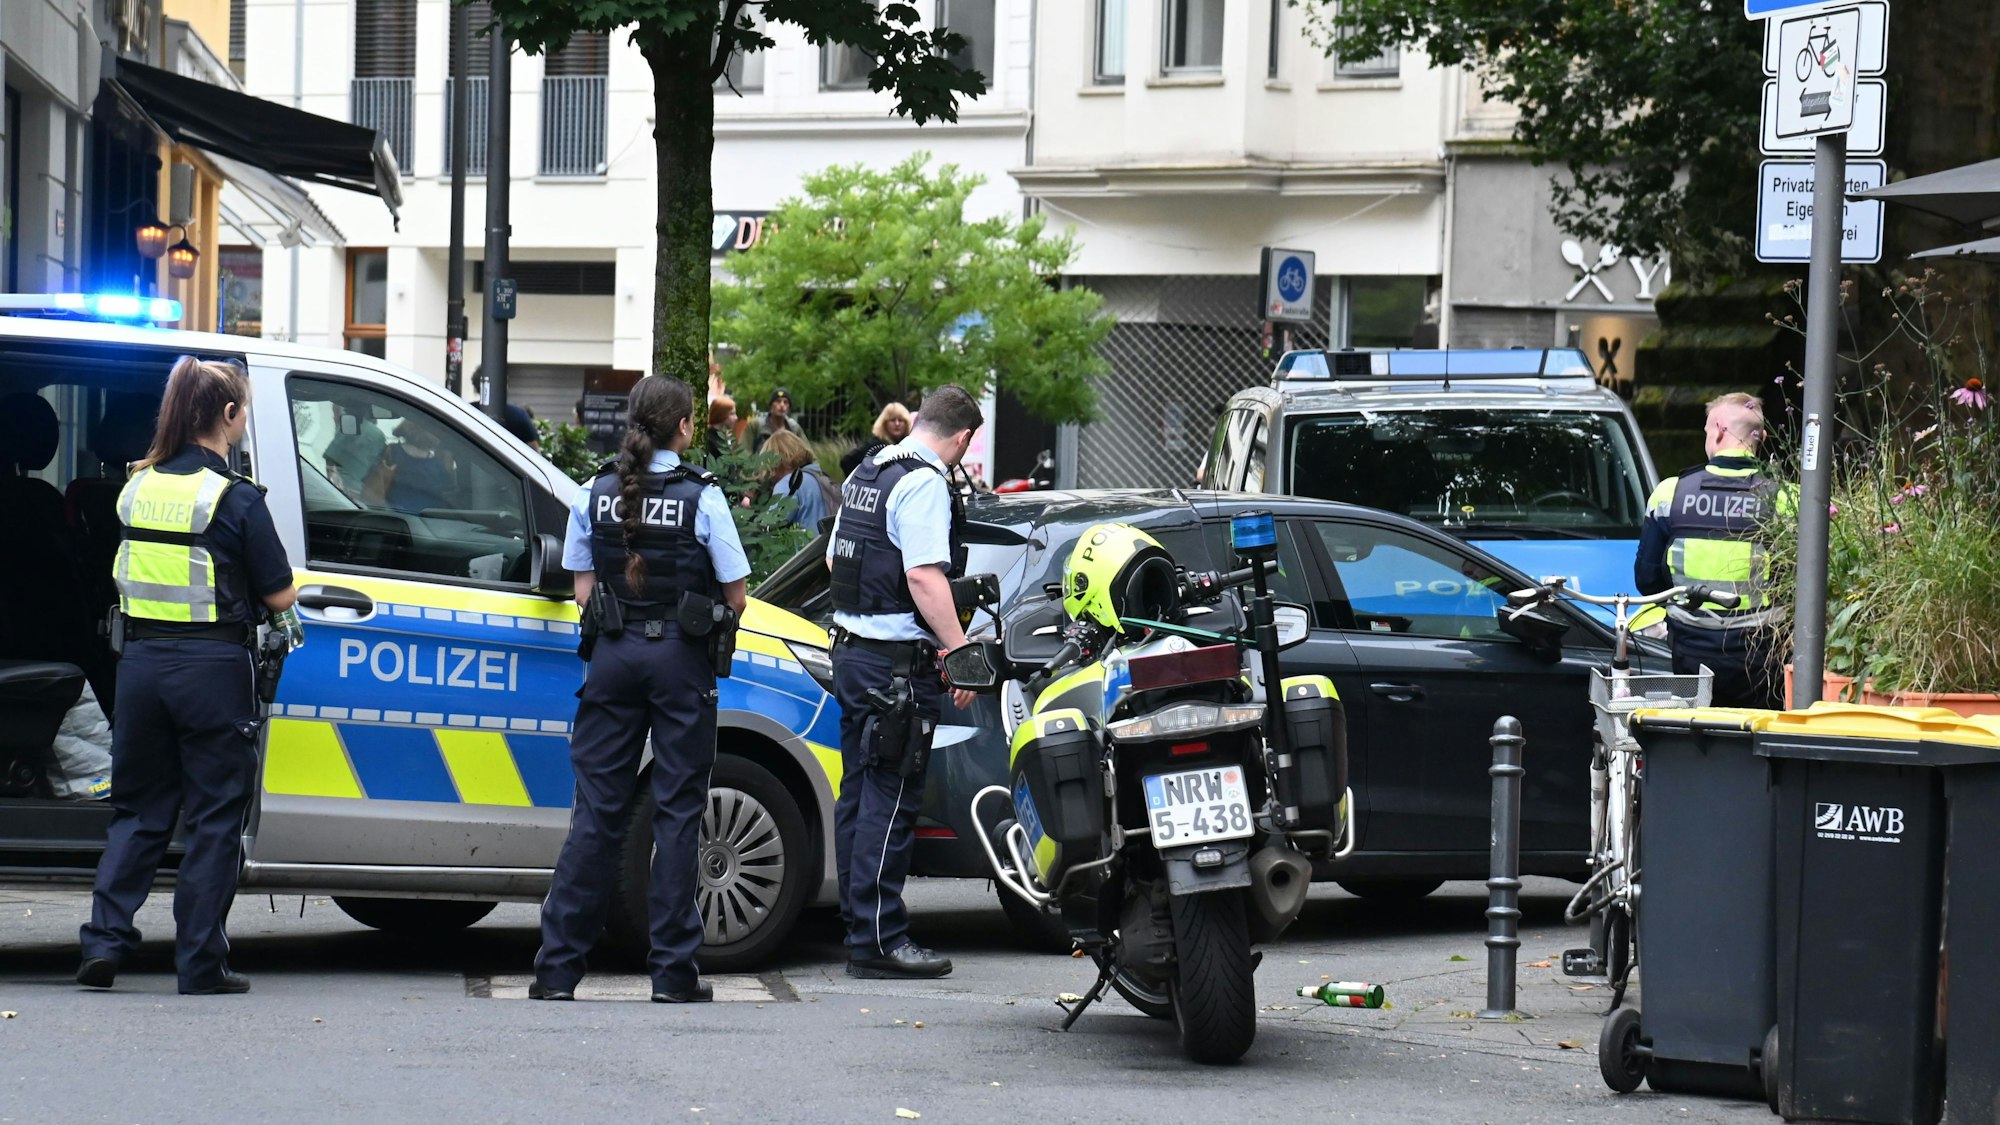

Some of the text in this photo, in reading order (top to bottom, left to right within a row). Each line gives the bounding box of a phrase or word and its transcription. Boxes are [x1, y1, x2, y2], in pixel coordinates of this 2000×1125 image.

[1773, 177, 1869, 193] Privatzrten
[132, 500, 191, 524] POLIZEI
[596, 495, 684, 526] POIZEI
[842, 483, 881, 513] POLIZEI
[1682, 494, 1761, 518] POLIZEI
[836, 538, 856, 558] NRW
[339, 638, 518, 692] POLIZEI
[1163, 771, 1223, 806] NRW
[1155, 802, 1248, 840] 5-438
[1845, 805, 1905, 834] AWB
